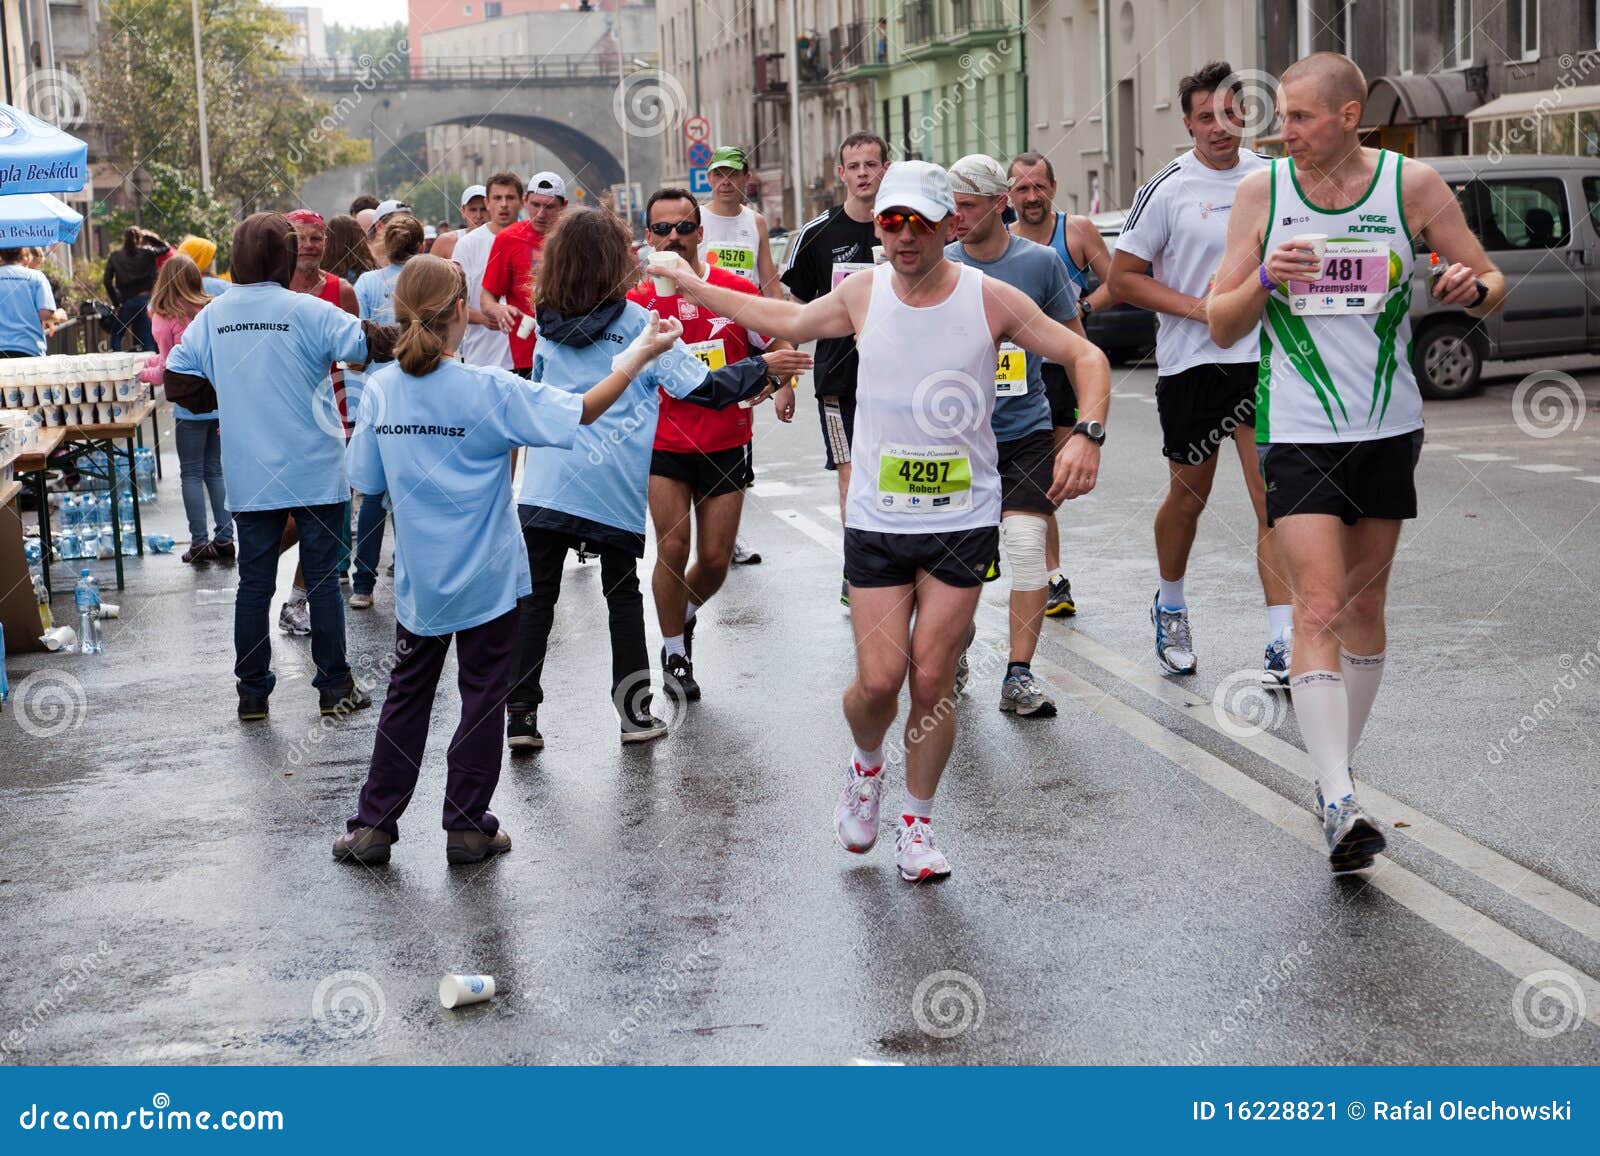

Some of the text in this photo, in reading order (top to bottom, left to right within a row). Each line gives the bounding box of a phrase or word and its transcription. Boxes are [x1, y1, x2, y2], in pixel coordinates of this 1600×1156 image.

[27, 162, 79, 180] Beskidu
[1358, 215, 1387, 223] VEGE
[10, 226, 54, 238] Beskidu
[1348, 225, 1396, 234] RUNNERS
[719, 250, 745, 261] 4576
[1325, 259, 1363, 280] 481
[1309, 283, 1367, 293] Przemysław
[217, 323, 290, 335] WOLONTARIUSZ
[375, 425, 466, 437] WOLONTARIUSZ
[899, 461, 950, 482] 4297
[909, 484, 941, 493] Robert
